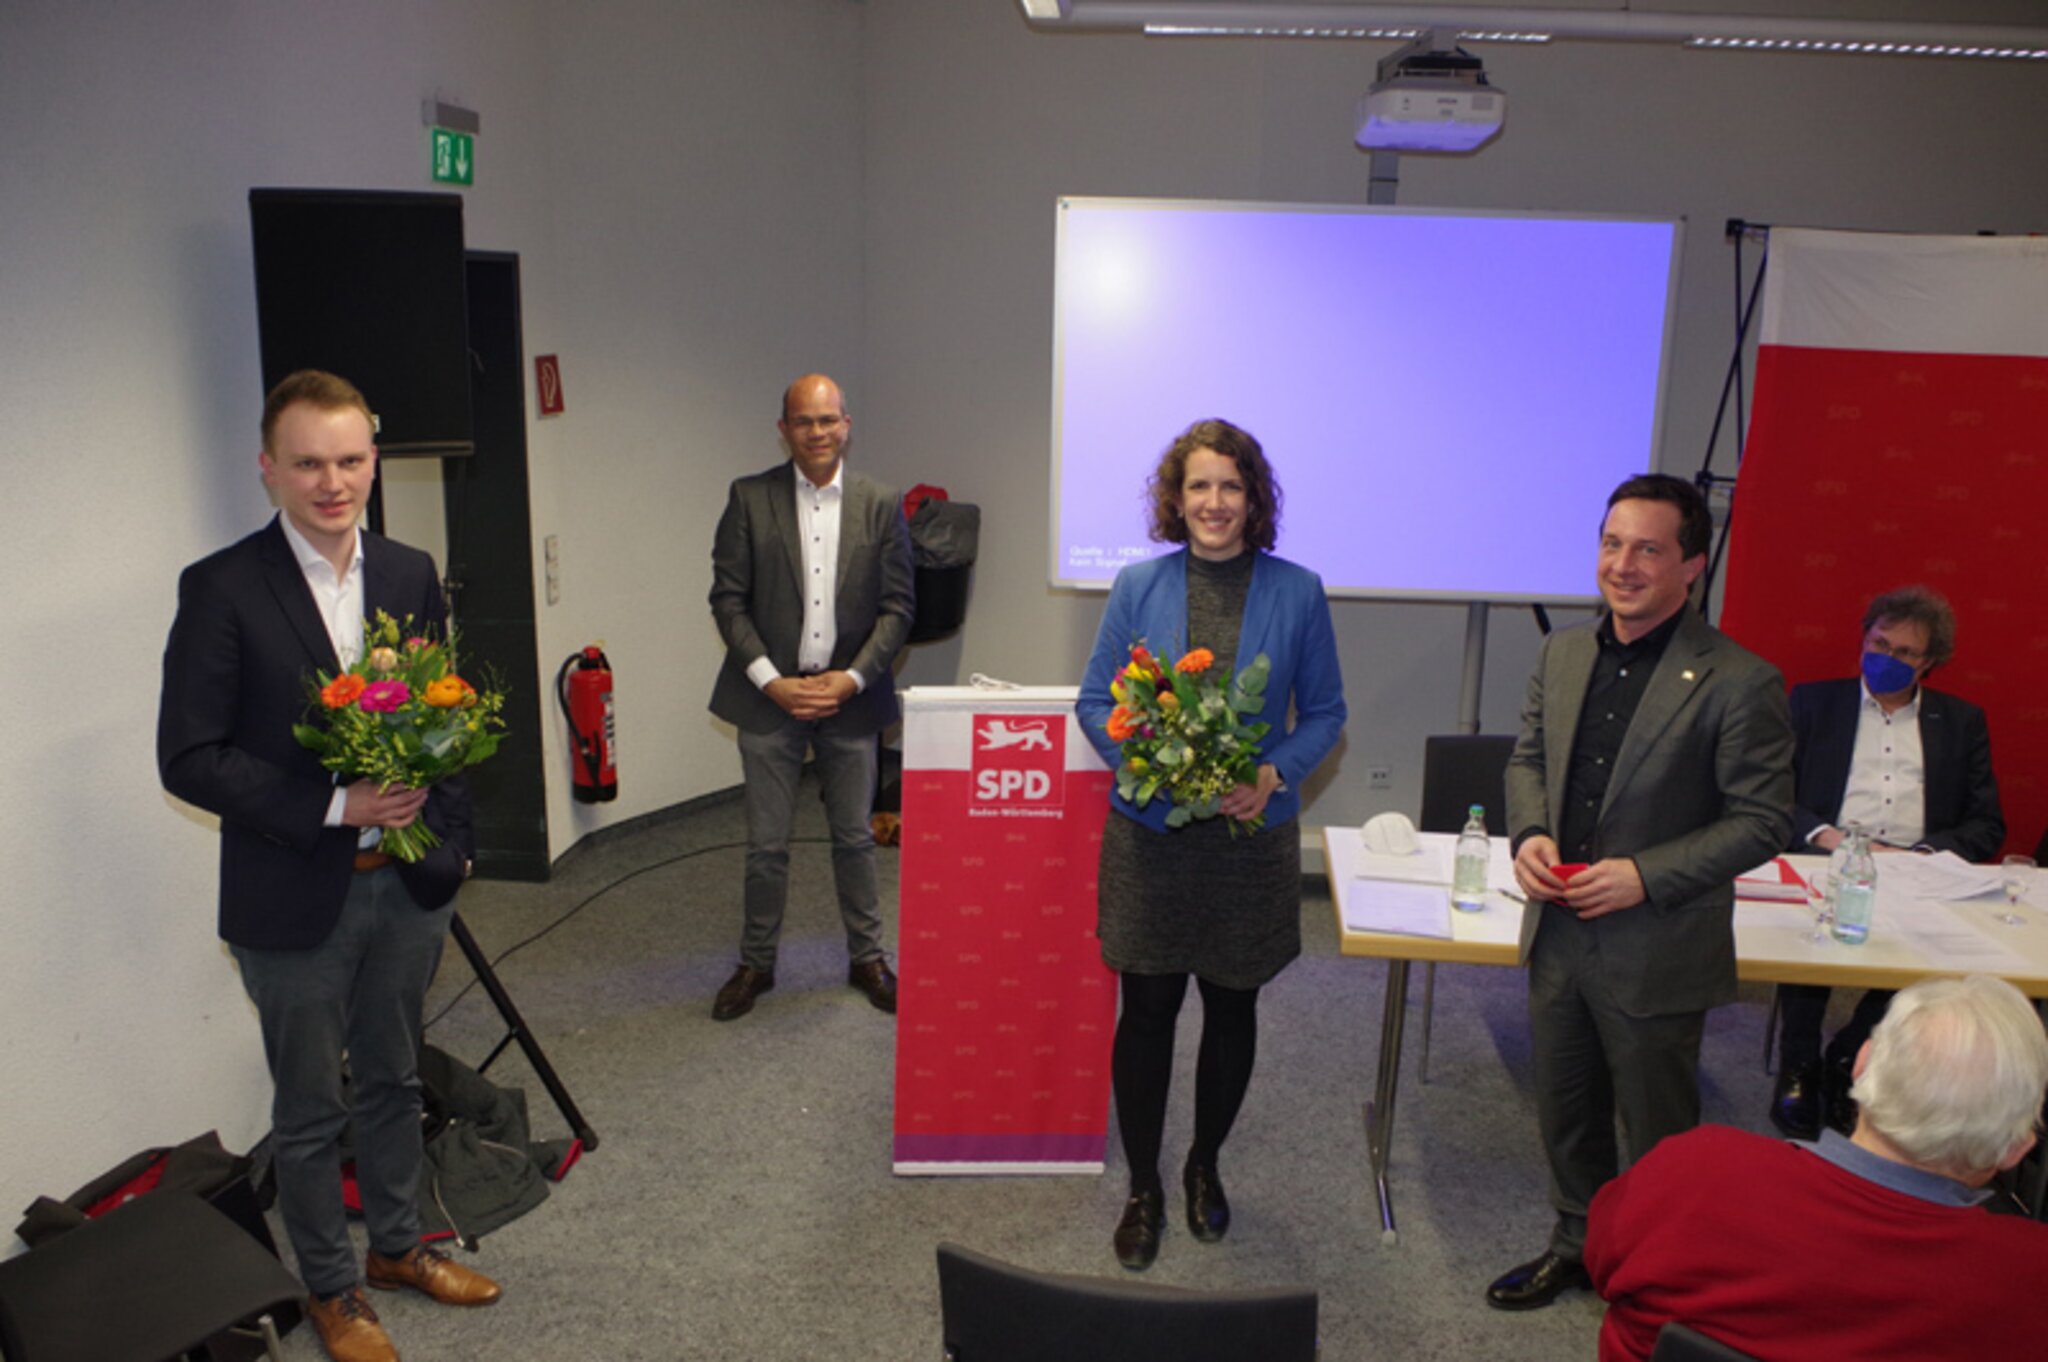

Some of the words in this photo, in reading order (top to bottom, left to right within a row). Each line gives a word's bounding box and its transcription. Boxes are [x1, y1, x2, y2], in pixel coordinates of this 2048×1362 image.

[1827, 405, 1861, 419] SPD
[1949, 411, 1983, 425] SPD
[1814, 480, 1847, 495] SPD
[1936, 485, 1969, 500] SPD
[1804, 554, 1837, 568] SPD
[1925, 559, 1957, 573] SPD
[976, 769, 1051, 800] SPD
[961, 856, 985, 867] SPD
[1043, 857, 1067, 867] SPD
[959, 905, 983, 916] SPD
[1041, 905, 1064, 916] SPD
[958, 953, 981, 963] SPD
[1039, 953, 1061, 963] SPD
